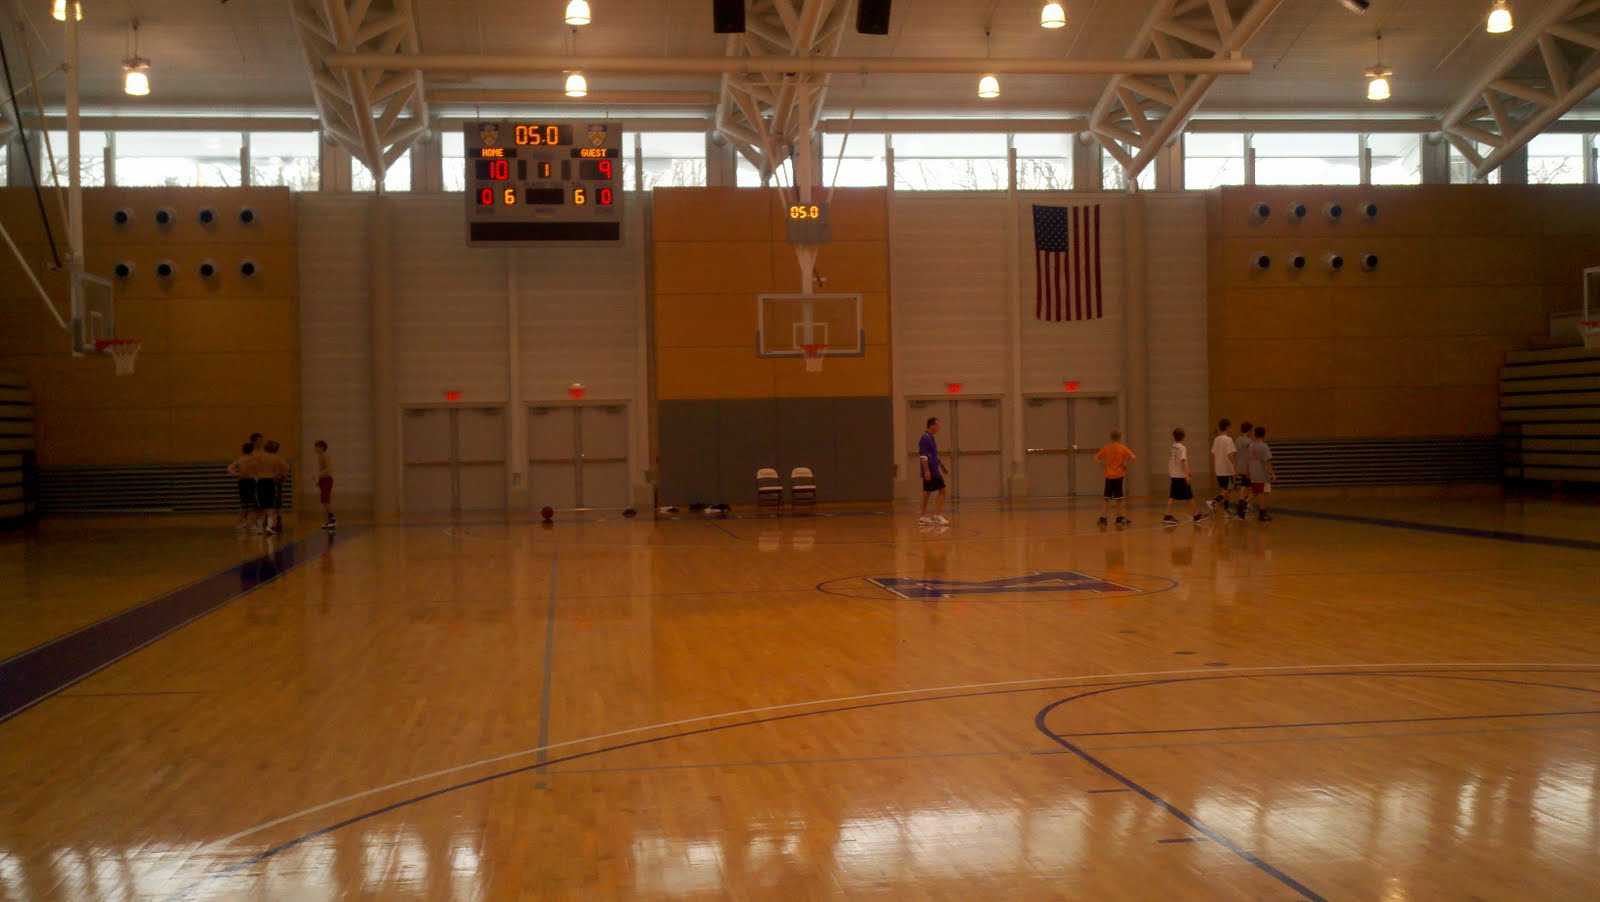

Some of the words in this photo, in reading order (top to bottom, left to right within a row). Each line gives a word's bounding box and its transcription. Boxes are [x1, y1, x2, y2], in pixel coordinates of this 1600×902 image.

[515, 125, 559, 145] 05.0
[481, 148, 504, 157] HOME
[581, 148, 607, 158] GUEST
[488, 160, 509, 180] 10
[544, 163, 550, 177] 1
[598, 160, 612, 179] 9
[481, 188, 493, 205] 0
[504, 188, 515, 205] 6
[574, 188, 585, 205] 6
[601, 188, 612, 205] 0
[790, 205, 819, 219] 05.0
